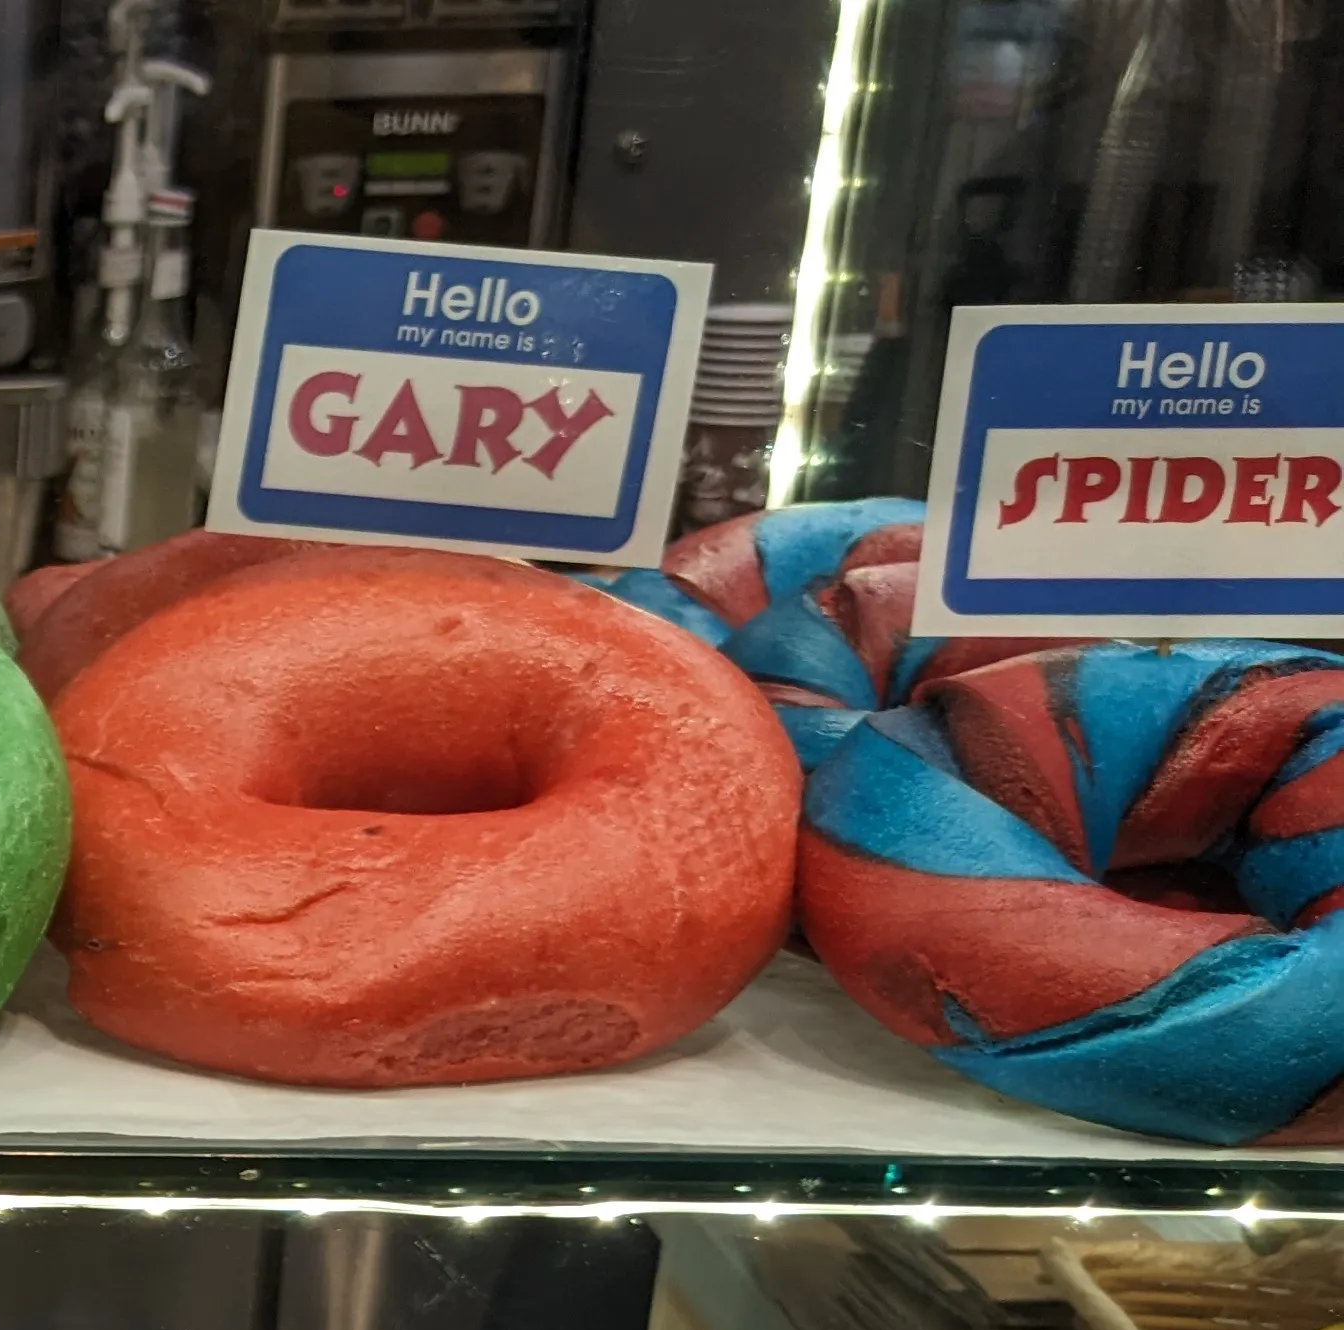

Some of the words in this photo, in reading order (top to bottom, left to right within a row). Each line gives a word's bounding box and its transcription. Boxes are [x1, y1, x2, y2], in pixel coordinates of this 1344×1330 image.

[402, 271, 540, 327] Hello
[397, 322, 434, 349] my
[440, 325, 509, 352] name
[515, 329, 535, 353] is
[1116, 341, 1266, 390] Hello
[287, 371, 615, 481] GARY
[1112, 396, 1152, 420] my
[1159, 395, 1235, 417] name
[1241, 394, 1261, 416] is
